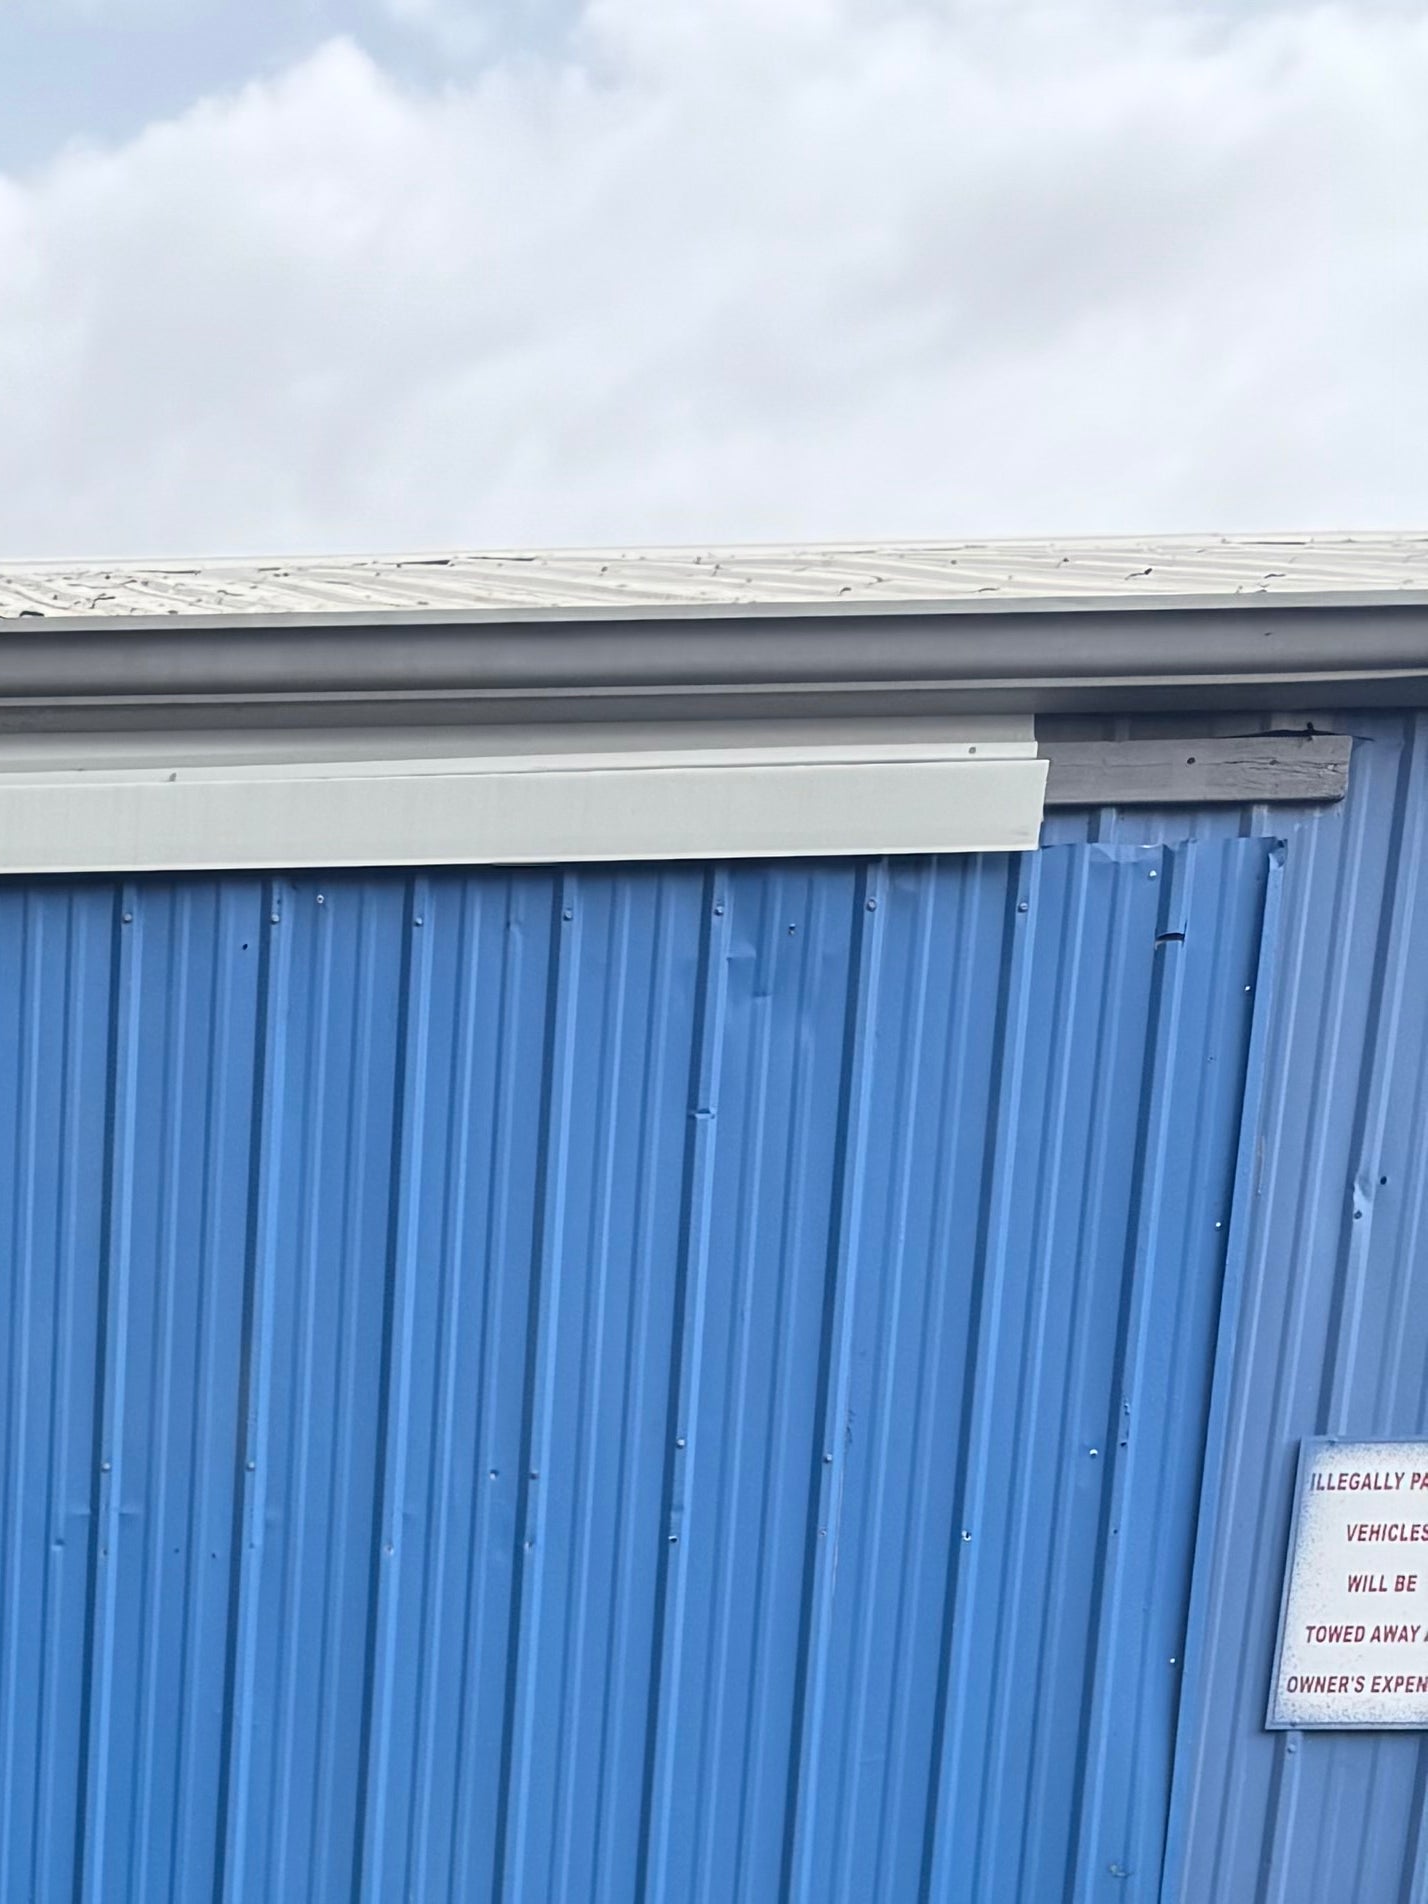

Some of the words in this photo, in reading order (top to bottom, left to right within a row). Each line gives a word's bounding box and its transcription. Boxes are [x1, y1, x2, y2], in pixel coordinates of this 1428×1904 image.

[1309, 1472, 1405, 1491] ILLEGALLY
[1347, 1574, 1388, 1593] WILL
[1394, 1574, 1418, 1592] BE
[1306, 1625, 1365, 1643] TOWED
[1370, 1625, 1421, 1643] AWAY
[1286, 1675, 1366, 1693] OWNER'S
